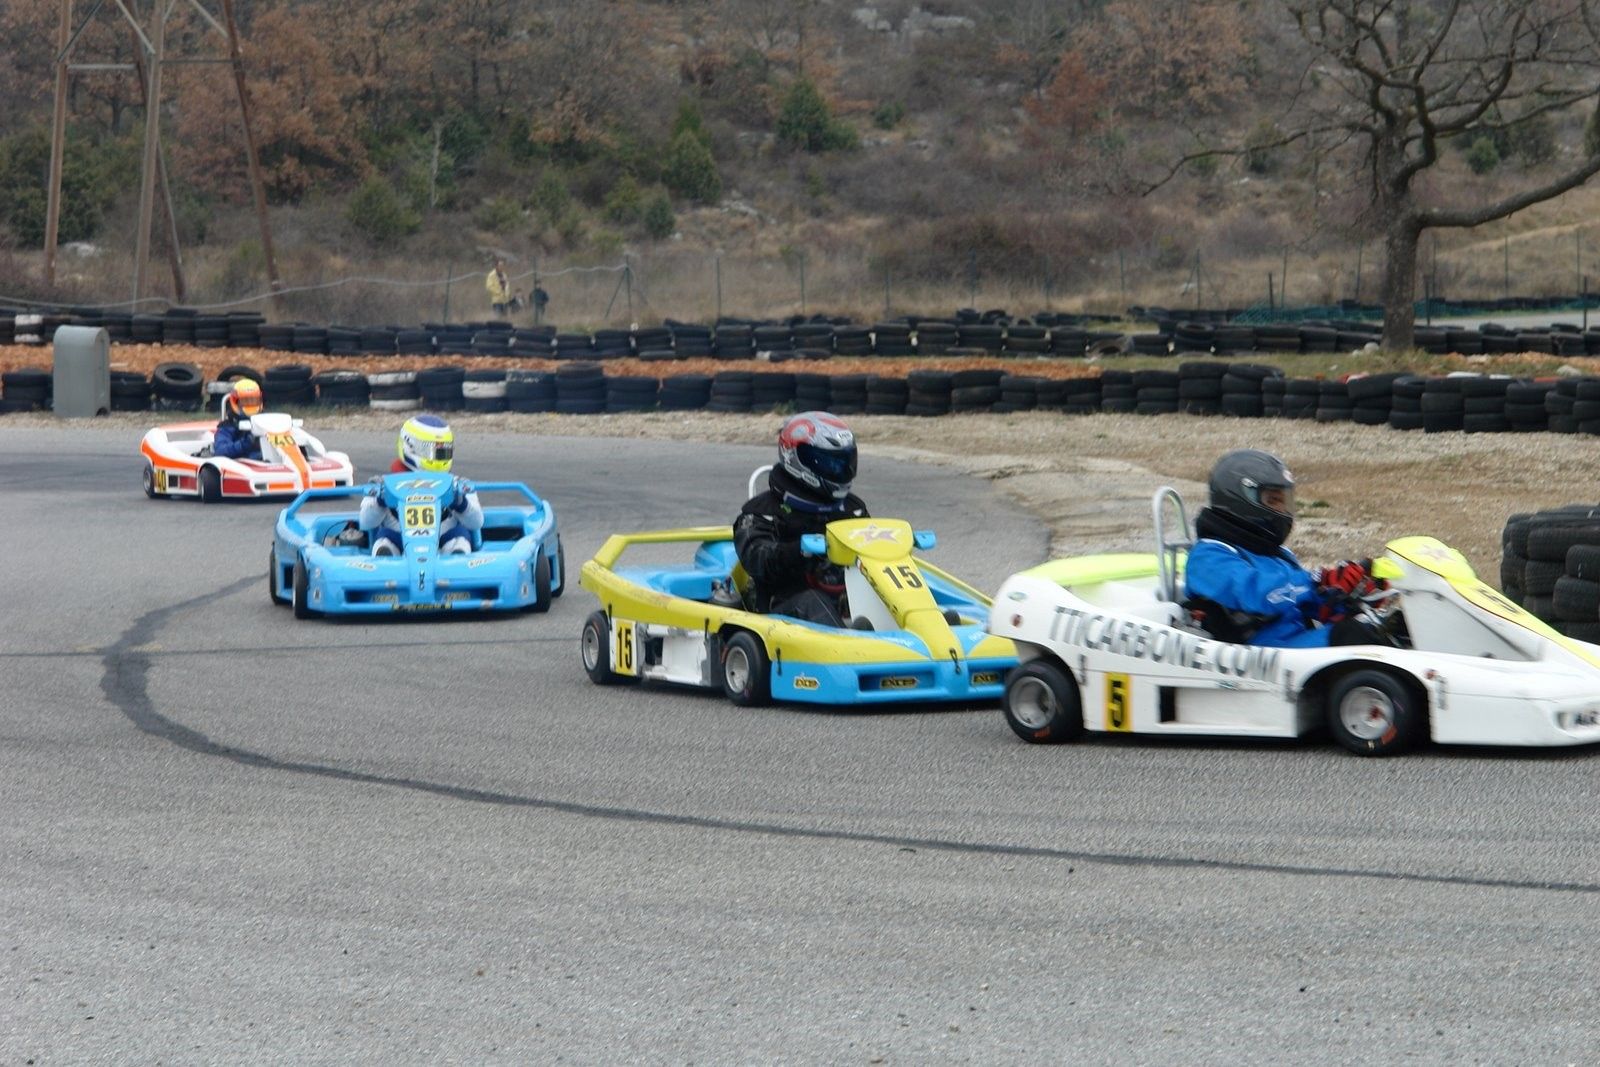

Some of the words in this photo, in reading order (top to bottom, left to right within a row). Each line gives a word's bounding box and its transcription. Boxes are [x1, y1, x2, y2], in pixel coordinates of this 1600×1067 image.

[406, 507, 435, 526] 36
[883, 565, 923, 590] 15
[617, 626, 633, 670] 15
[1109, 679, 1126, 729] 5
